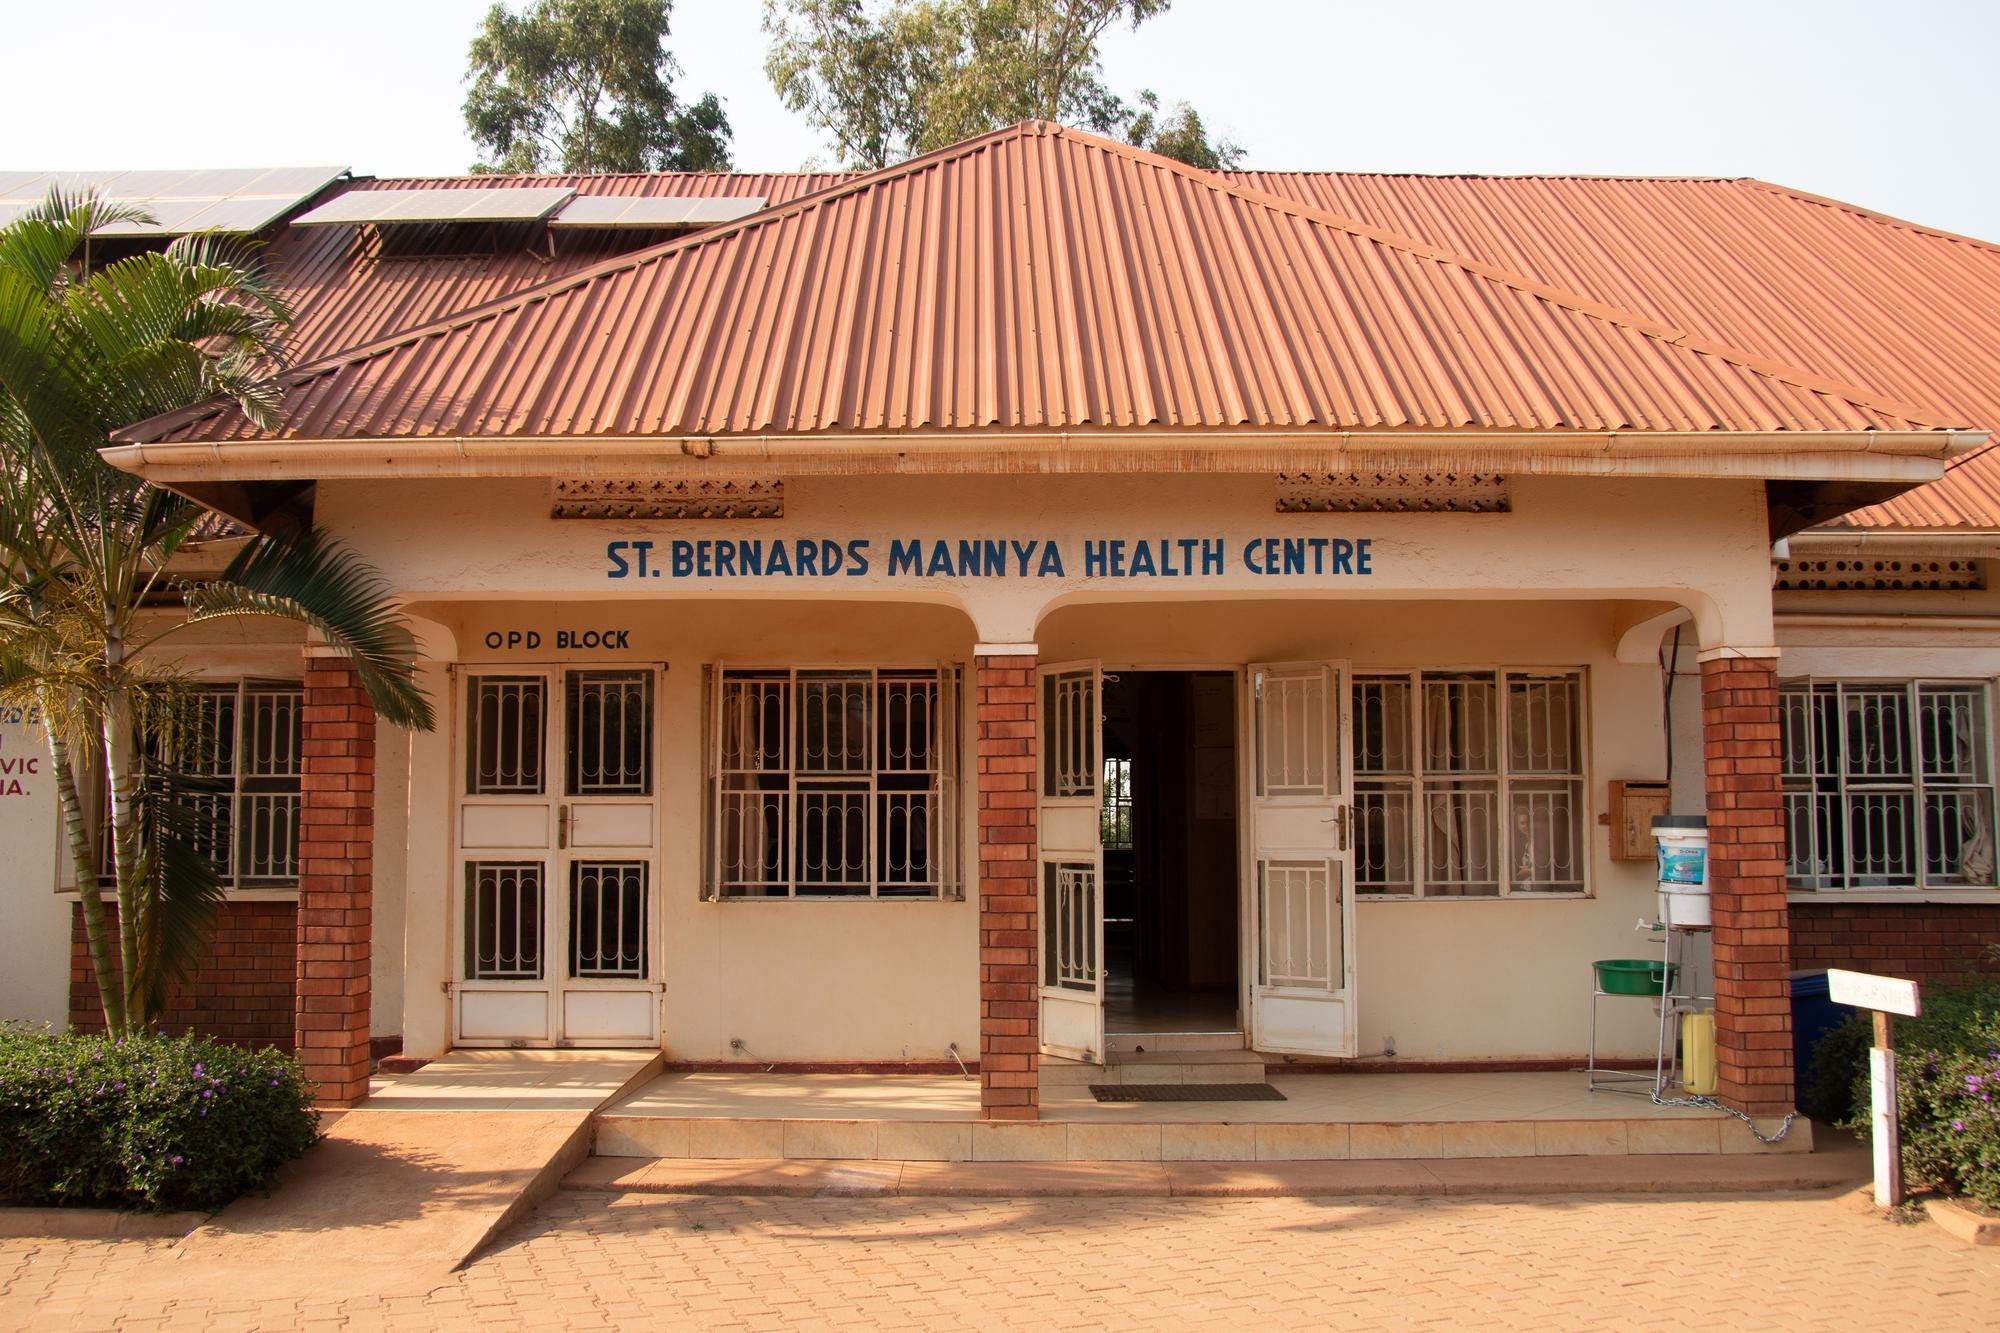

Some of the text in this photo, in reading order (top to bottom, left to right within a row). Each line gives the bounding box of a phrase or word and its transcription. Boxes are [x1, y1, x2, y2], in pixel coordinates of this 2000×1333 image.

[607, 537, 1373, 578] ST. BERNARDS MANNYA HEALTH CENTRE
[485, 630, 630, 649] OPD BLOCK
